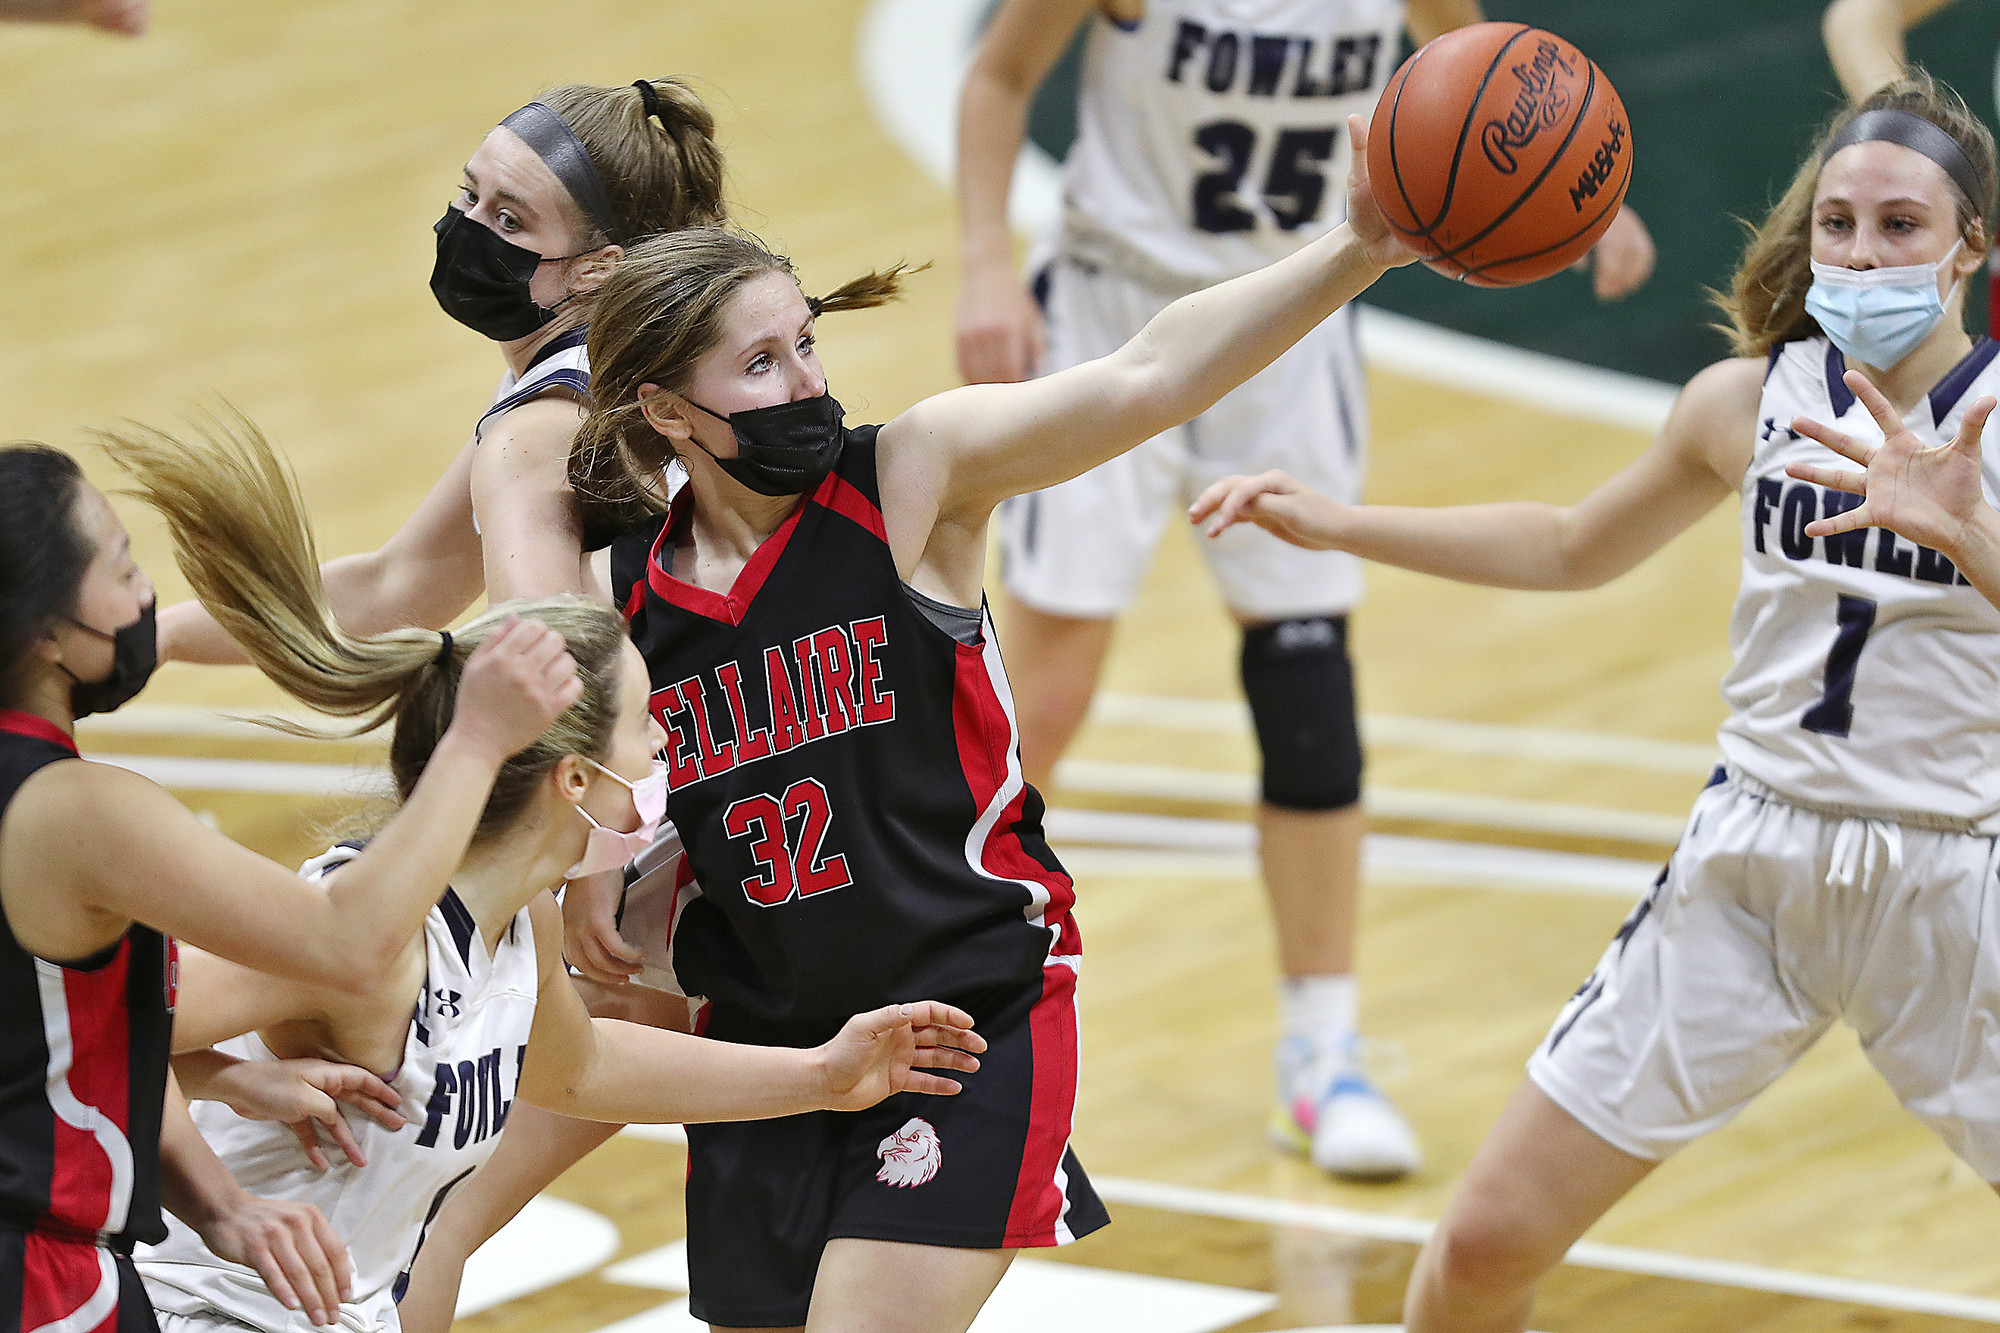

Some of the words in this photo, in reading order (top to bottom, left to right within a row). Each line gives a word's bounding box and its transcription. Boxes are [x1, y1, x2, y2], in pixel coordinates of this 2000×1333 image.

[1481, 37, 1574, 175] Rawlings
[1194, 120, 1339, 232] 25
[1754, 477, 1972, 586] FOWL
[649, 615, 896, 793] ELLAIRE
[1801, 593, 1877, 738] 1
[722, 777, 853, 907] 32
[414, 1044, 528, 1150] FOWL
